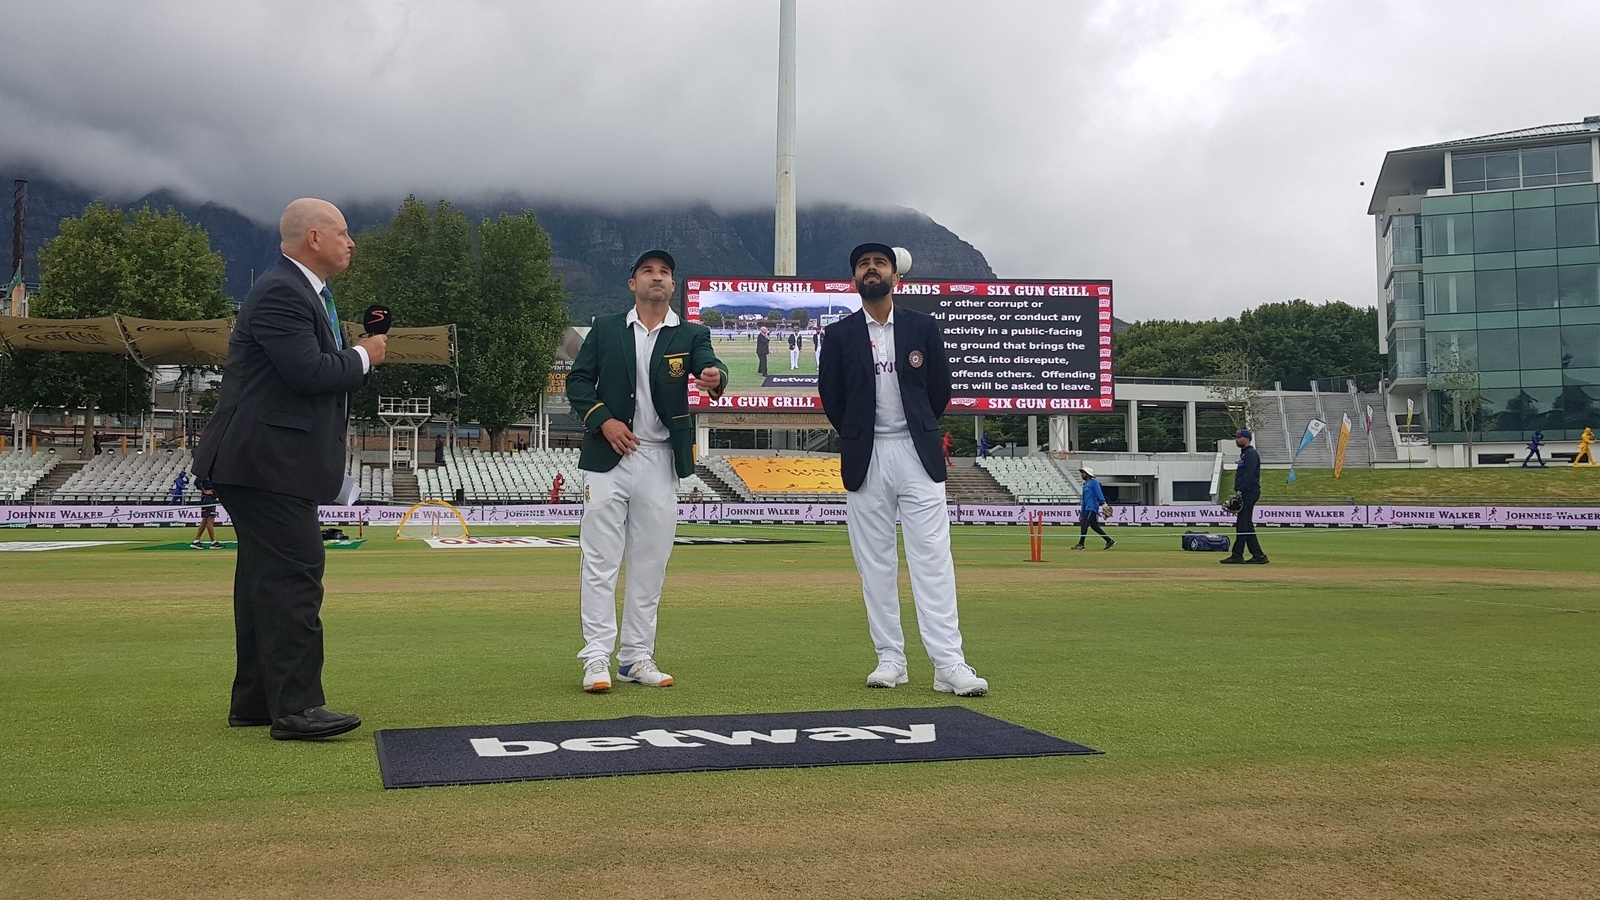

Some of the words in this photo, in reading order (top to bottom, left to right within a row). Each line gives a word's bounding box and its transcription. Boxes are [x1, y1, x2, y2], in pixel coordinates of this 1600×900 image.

[709, 281, 733, 292] SIX
[738, 281, 769, 292] GUN
[772, 282, 814, 293] GRILL
[893, 284, 941, 295] LANDS
[987, 285, 1010, 296] SIX
[1014, 286, 1045, 296] GUN
[1048, 286, 1090, 297] GRILL
[955, 299, 986, 308] other
[987, 300, 1029, 310] corrupt
[948, 314, 997, 323] purpose,
[1014, 313, 1058, 321] conduct
[1061, 314, 1081, 323] any
[944, 327, 984, 337] activity
[988, 327, 998, 335] in
[1011, 327, 1082, 337] public-facing
[944, 341, 958, 349] he
[960, 341, 1000, 351] ground
[1003, 341, 1026, 350] that
[1029, 342, 1064, 351] brings
[1066, 342, 1085, 350] the
[964, 356, 986, 364] CSA
[988, 356, 1011, 364] into
[1013, 356, 1070, 366] disrepute,
[772, 376, 818, 384] betway
[951, 370, 994, 378] offends
[996, 370, 1035, 378] others.
[1041, 371, 1096, 380] Offending
[971, 382, 992, 390] will
[994, 382, 1009, 390] be
[1011, 382, 1043, 391] asked
[1046, 383, 1058, 391] to
[1061, 383, 1094, 391] leave.
[709, 397, 733, 407] SIX
[738, 397, 769, 407] GUN
[772, 397, 815, 408] GRILL
[988, 398, 1013, 408] SIX
[1016, 399, 1046, 408] GUN
[1049, 399, 1091, 409] GRILL
[6, 510, 56, 521] JOHNNIE
[60, 510, 103, 519] WALKER
[128, 510, 174, 520] JOHNNIE
[178, 510, 219, 518] WALR
[317, 510, 356, 518] WALKER
[725, 507, 765, 517] JOHNNIE
[767, 507, 800, 516] WALKER
[819, 508, 848, 517] JOHNN
[977, 509, 1013, 517] WALKER
[1155, 510, 1196, 520] JOHNNIE
[1259, 510, 1301, 519] JOHNNIE
[1304, 510, 1345, 518] WALKER
[1390, 510, 1435, 520] JOHNNIE
[1438, 511, 1481, 519] WALKER
[1505, 511, 1552, 520] JOHNNIE
[469, 723, 936, 758] betway
